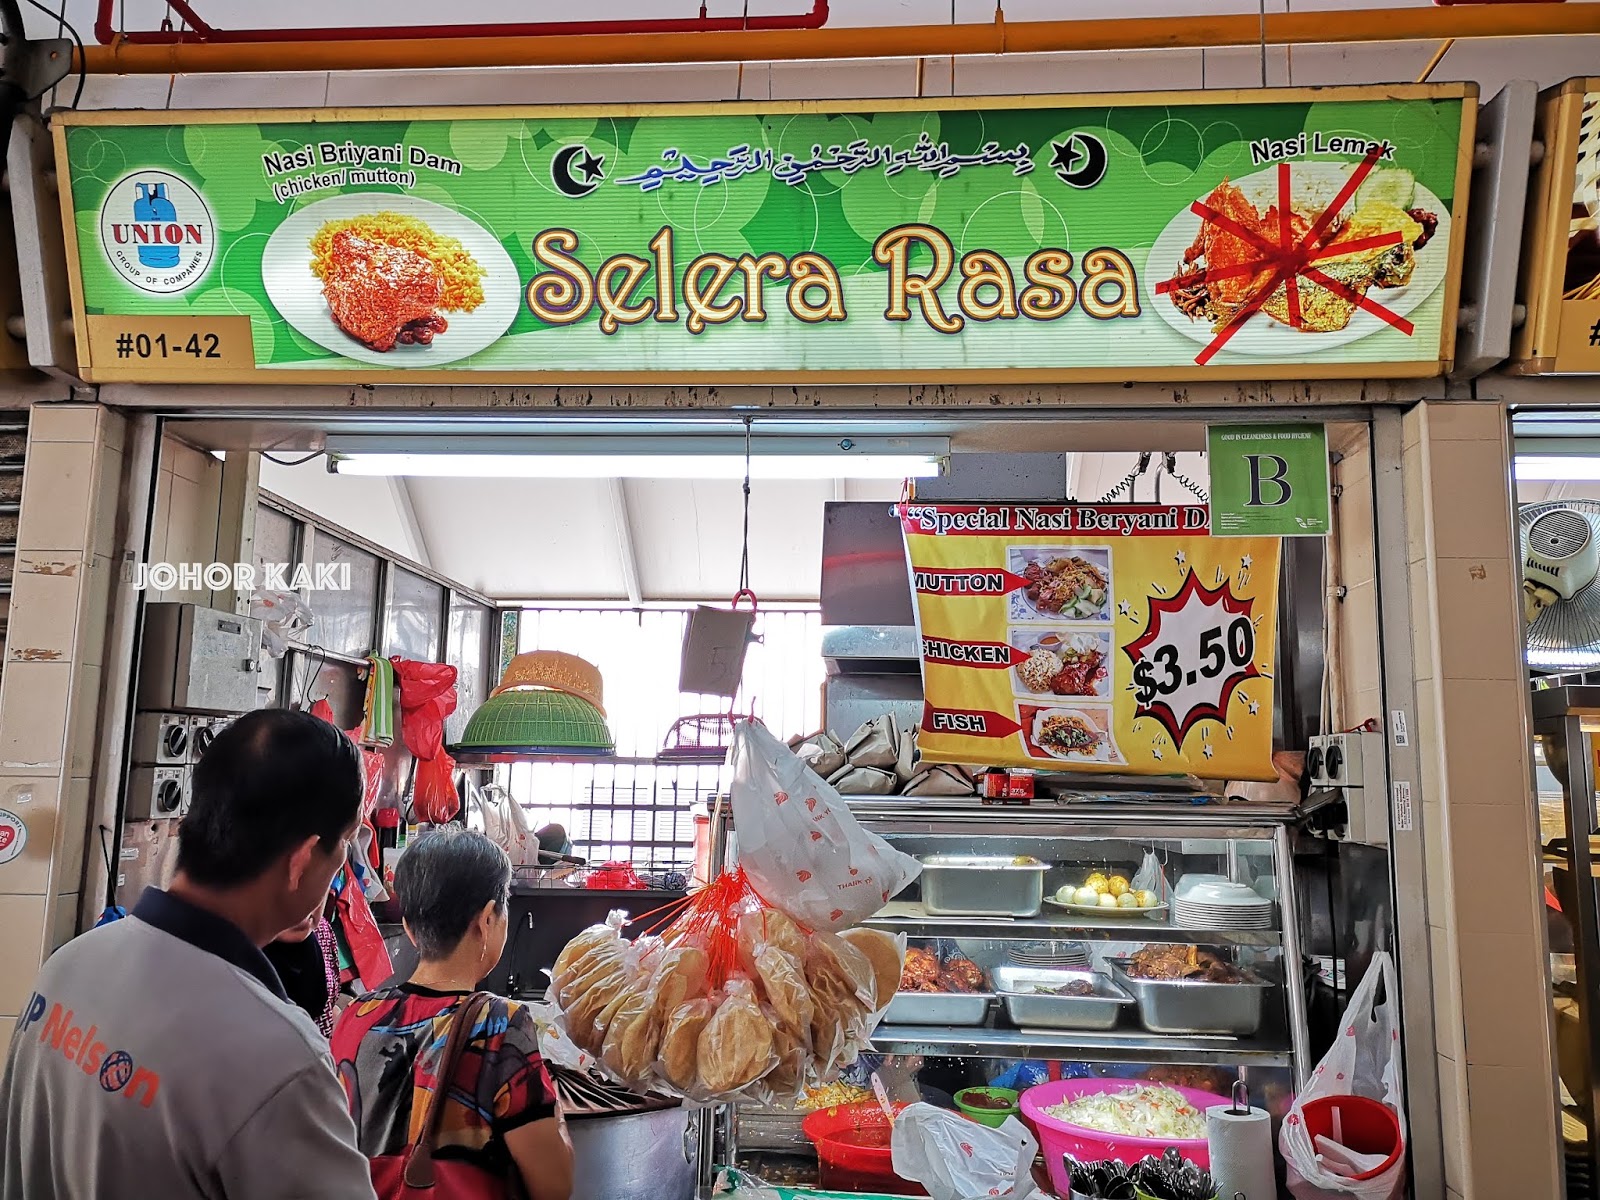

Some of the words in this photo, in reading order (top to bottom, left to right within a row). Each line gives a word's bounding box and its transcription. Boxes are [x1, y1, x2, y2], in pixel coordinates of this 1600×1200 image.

[263, 145, 315, 176] Nasi
[320, 142, 402, 166] Briyani
[409, 147, 461, 175] Dam
[1251, 133, 1306, 164] Nasi
[1314, 132, 1395, 160] Lemak
[274, 169, 346, 203] (chicken/
[350, 169, 416, 187] mutton)
[111, 223, 203, 245] UNION
[116, 250, 141, 277] GROUP
[145, 276, 158, 285] OF
[163, 250, 203, 286] COMPANIES
[525, 224, 847, 336] Selera
[872, 221, 1142, 335] Rasa
[116, 332, 221, 359] #01-42
[1242, 453, 1293, 508] B
[1014, 506, 1072, 530] Nasi
[1077, 506, 1179, 536] Beryani
[1133, 615, 1255, 710] $3.50
[932, 712, 987, 732] FISH
[837, 879, 863, 890] THANK
[40, 1002, 160, 1109] Nelson
